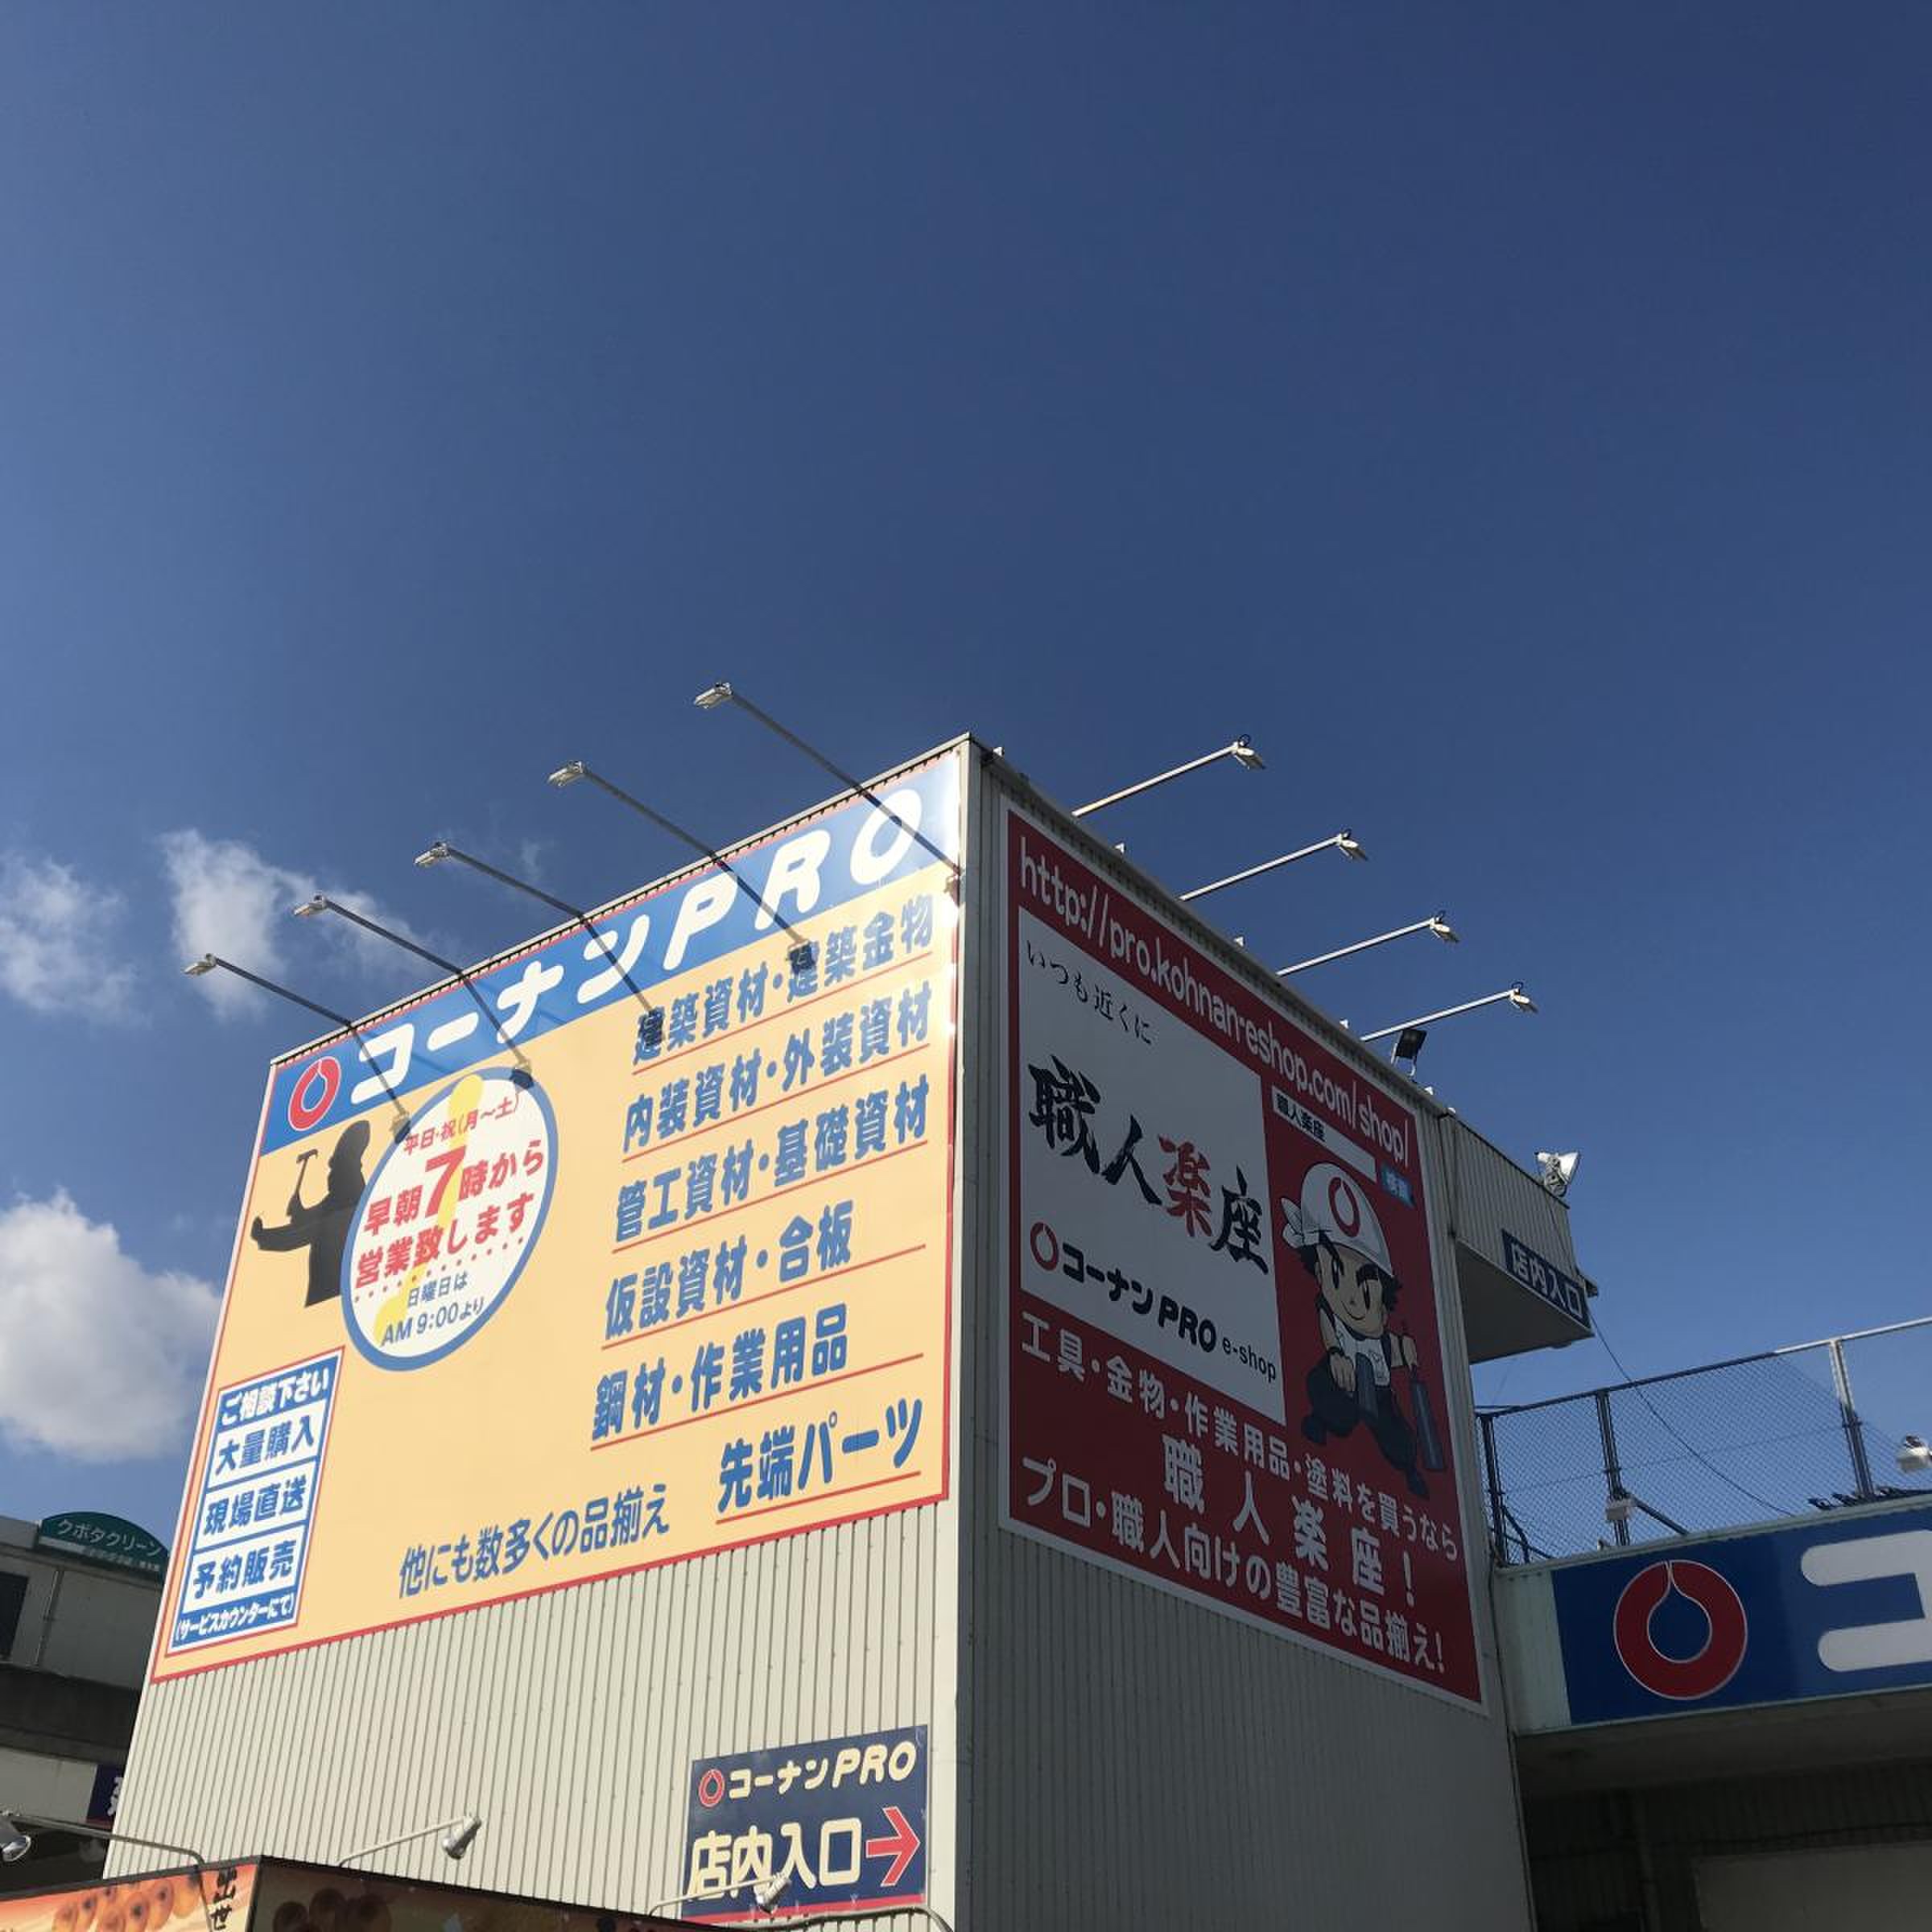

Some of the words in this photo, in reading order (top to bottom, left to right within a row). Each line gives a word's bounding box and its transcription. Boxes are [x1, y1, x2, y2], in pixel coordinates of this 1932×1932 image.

[1027, 940, 1152, 1045] いつも近くに
[623, 980, 932, 1153] 内装資材・外装資材
[364, 1139, 544, 1236] 早朝7時から
[616, 1073, 929, 1242] 管工資材・基礎資材
[1027, 1055, 1269, 1275] 職人楽座
[356, 1193, 535, 1288] 営業致します
[605, 1199, 853, 1340] 仮設資材・合板
[1511, 1242, 1583, 1319] 店内入口
[407, 1272, 469, 1308] 日曜日は
[221, 1368, 329, 1423] ご相談下さい
[592, 1303, 848, 1441] 鋼材・作業用品
[1222, 1336, 1276, 1383] e-shop
[216, 1415, 314, 1476] 大量購入
[718, 1398, 922, 1513] 先端パーツ
[57, 1519, 162, 1556] クボタクリーン
[204, 1475, 307, 1535] 現場直送
[399, 1484, 670, 1600] 他にも数多くの品揃え
[193, 1539, 297, 1600] 予約販売
[729, 1740, 917, 1799] コーナンPRO
[687, 1817, 862, 1902] 店内入口
